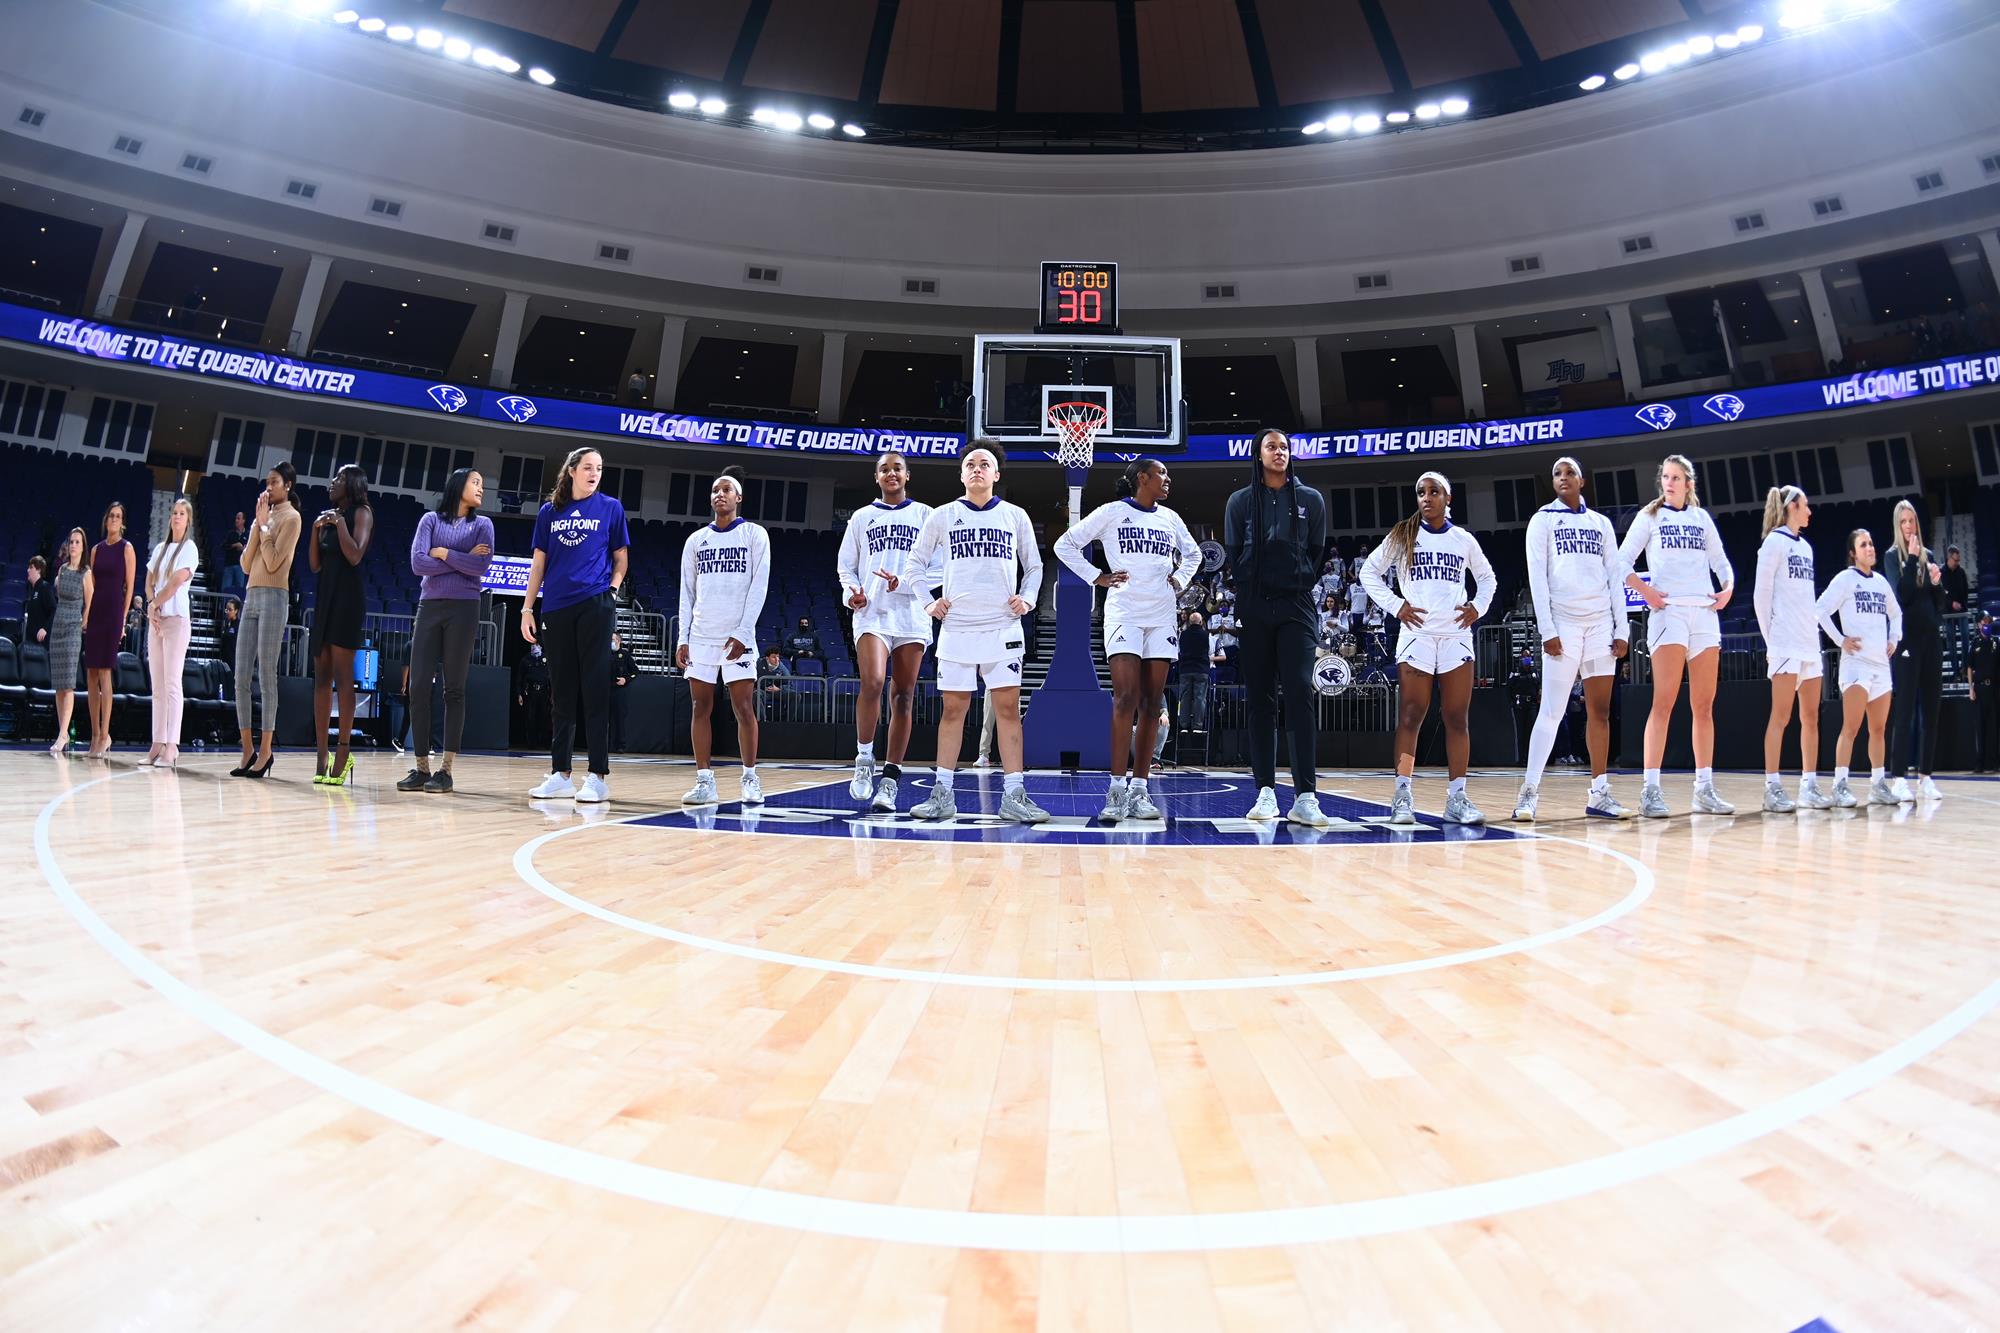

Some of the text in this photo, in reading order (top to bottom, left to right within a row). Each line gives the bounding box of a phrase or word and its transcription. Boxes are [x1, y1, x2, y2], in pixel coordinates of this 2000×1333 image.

[1058, 271, 1108, 288] 10:00
[1059, 290, 1101, 322] 30
[38, 318, 355, 393] WELCOME TO THE QUBEIN CENTER
[1545, 359, 1585, 383] HPU
[1822, 370, 1918, 405] WELCOME
[1919, 365, 1945, 389] TO
[1945, 359, 1984, 385] THE
[619, 413, 958, 455] WELCOME TO THE QUBEIN CENTER
[1228, 419, 1563, 457] WOME TO THE QUBEIN CENTER
[551, 519, 600, 533] HIGH POINT
[866, 525, 920, 543] HIGH POINT
[1117, 527, 1145, 540] HIGH
[1554, 528, 1577, 541] HIGH
[1659, 525, 1681, 536] HIGH
[558, 533, 588, 547] BASKETBALL
[949, 528, 1013, 546] HIGH POINT
[718, 547, 748, 560] POINT
[869, 537, 916, 556] PANTHER
[951, 542, 1013, 560] PANTHERS
[1119, 540, 1171, 558] PANTHER
[488, 564, 531, 573] ELCOM
